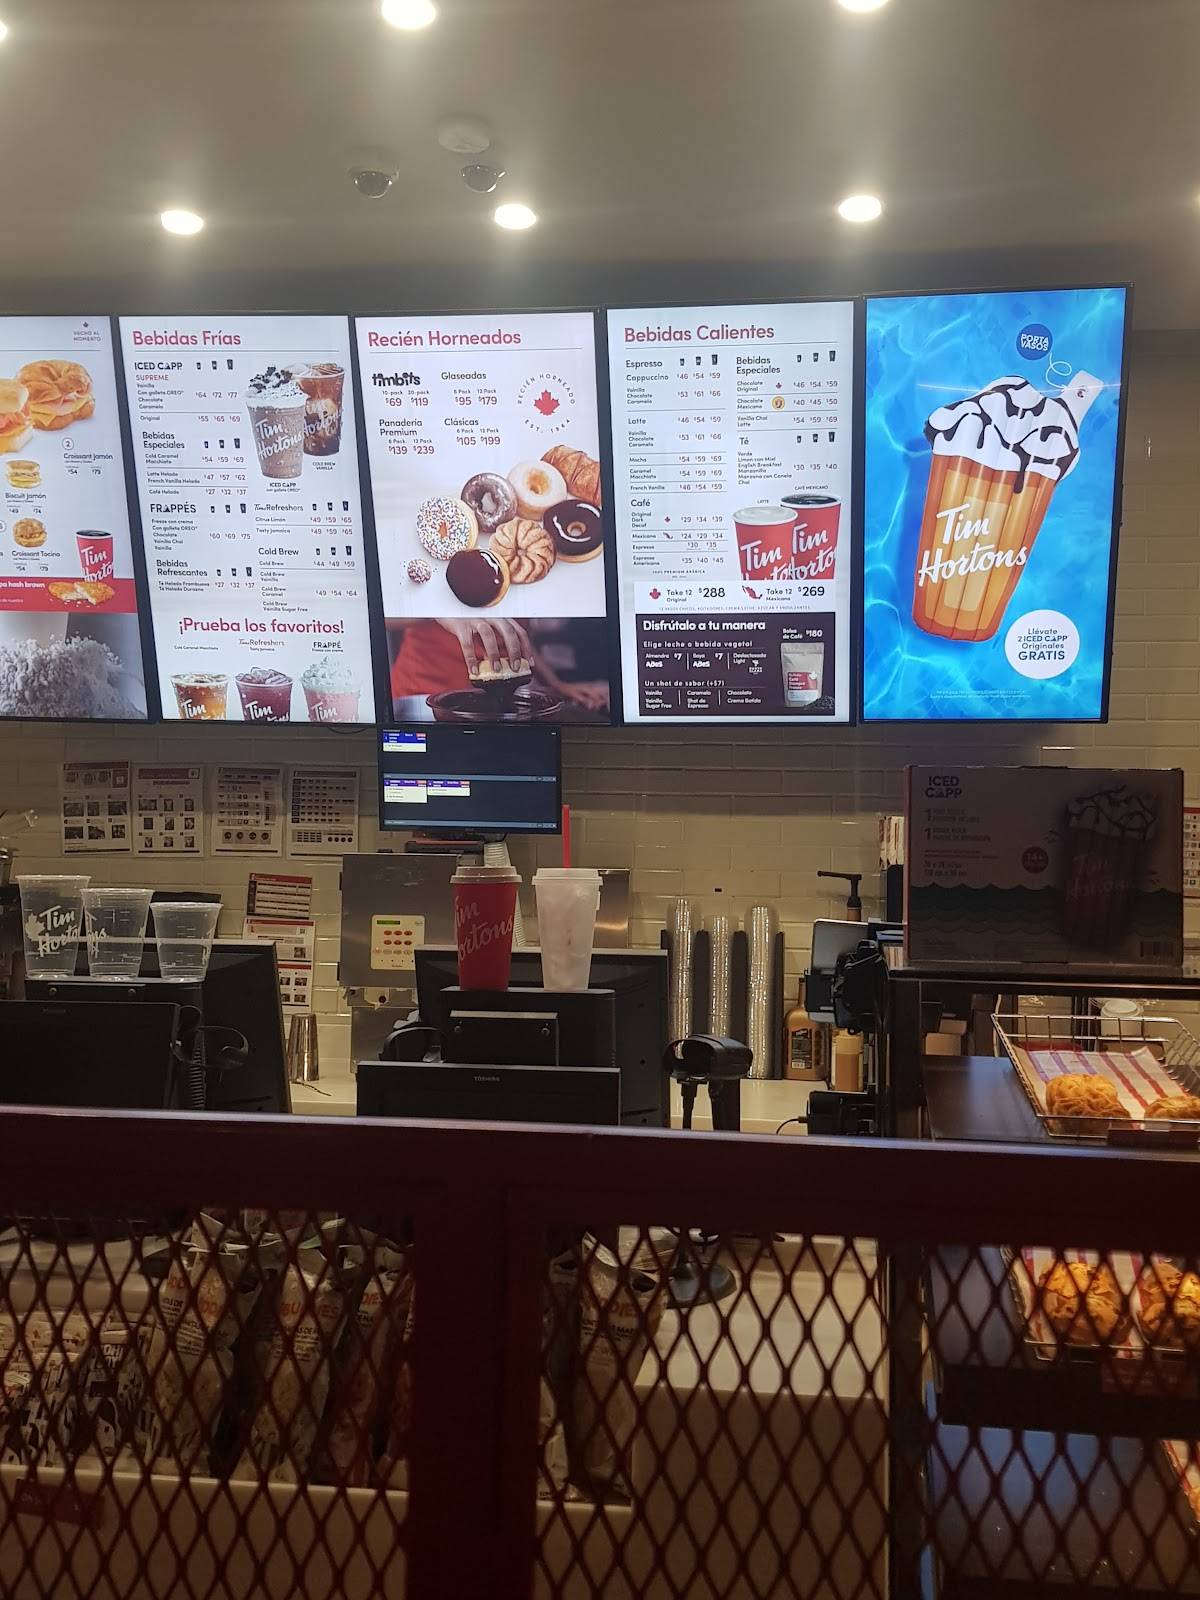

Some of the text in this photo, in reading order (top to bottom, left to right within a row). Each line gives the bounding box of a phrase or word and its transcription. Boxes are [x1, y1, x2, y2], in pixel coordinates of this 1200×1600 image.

[132, 330, 241, 345] Bebidas Frías
[368, 329, 521, 347] Recién Horneados
[624, 324, 774, 342] Bebidas Calientes
[1020, 333, 1049, 345] PORTA
[1021, 340, 1048, 351] VASOS
[625, 359, 663, 370] Espresso
[736, 356, 771, 365] Bebidas
[134, 362, 183, 370] ICED CAPP
[736, 366, 781, 376] Especiales
[372, 372, 421, 387] timbits
[441, 371, 487, 380] Glaseadas
[626, 373, 669, 383] Cappuccino
[385, 397, 429, 407] $69 $119
[455, 396, 497, 406] $95 $179
[379, 418, 423, 427] Panadería
[444, 418, 479, 426] Clásicas
[142, 431, 175, 440] Bebidas
[380, 428, 418, 436] Premium
[143, 440, 185, 450] Especiales
[456, 436, 500, 446] $105 $199
[388, 446, 435, 455] $139 $239
[93, 453, 113, 461] Jamón
[27, 492, 46, 500] Jamón
[150, 501, 197, 513] FRAPPÉS
[630, 499, 651, 507] Café
[936, 503, 990, 545] Tim
[792, 523, 828, 555] Tim
[80, 546, 107, 567] Tim
[740, 540, 782, 571] Tim
[156, 559, 188, 567] Bebidas
[918, 541, 1027, 587] Hortons
[157, 568, 208, 576] Refrescantes
[698, 587, 726, 598] $288
[797, 586, 825, 597] $269
[178, 617, 345, 635] ¡Prueba los favoritos!
[643, 619, 766, 631] Disfrútalo a tu manera
[806, 630, 823, 638] $180
[313, 640, 342, 649] FRAPPÉ
[643, 641, 662, 649] Elige
[724, 640, 753, 649] vegetal
[1021, 642, 1064, 651] Originales
[1018, 650, 1065, 661] GRATIS
[181, 698, 207, 719] Tim
[244, 700, 272, 720] Tim
[311, 702, 338, 721] Tim
[928, 775, 960, 786] ICED
[39, 905, 75, 930] Tim
